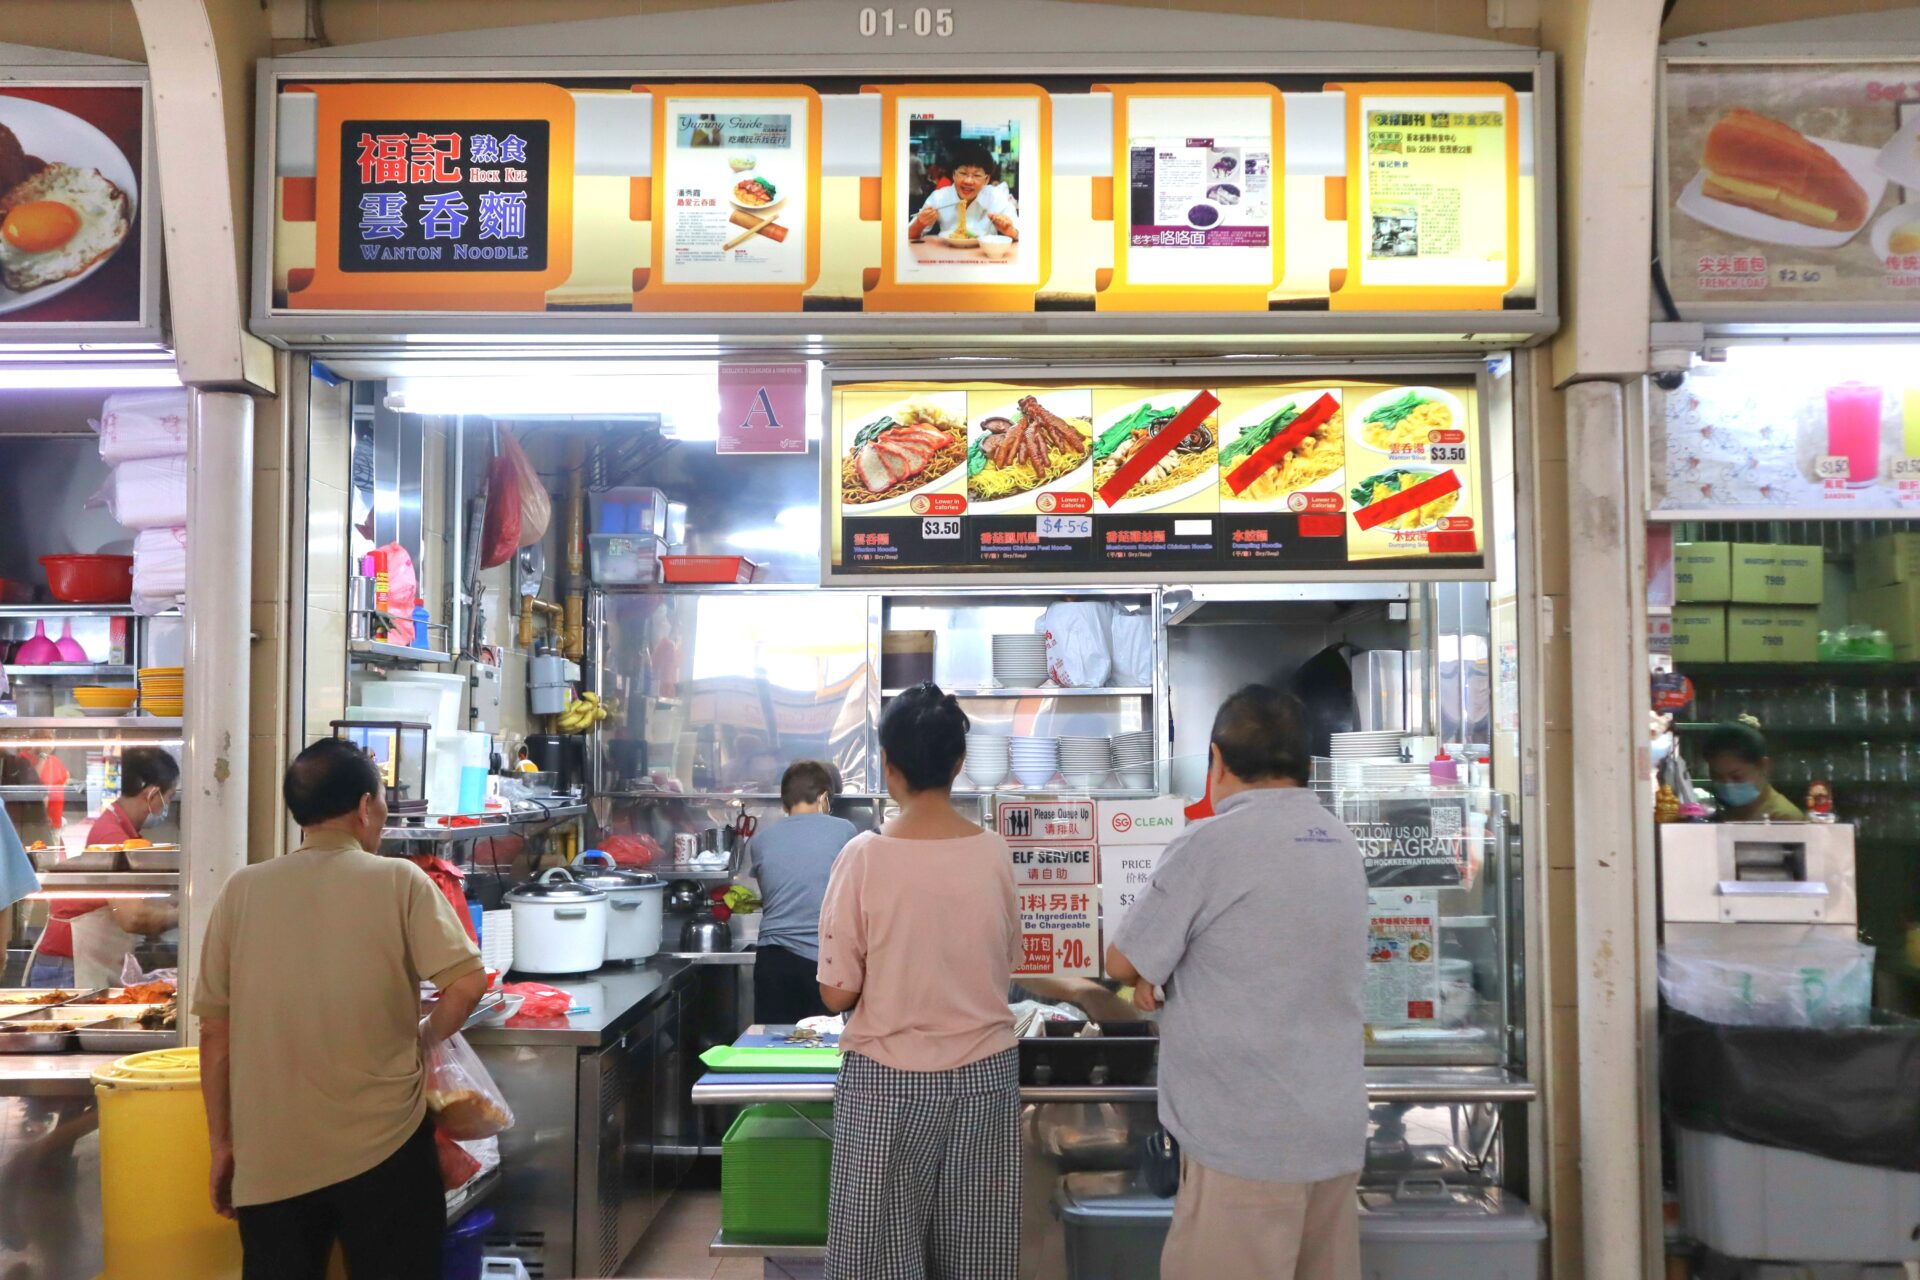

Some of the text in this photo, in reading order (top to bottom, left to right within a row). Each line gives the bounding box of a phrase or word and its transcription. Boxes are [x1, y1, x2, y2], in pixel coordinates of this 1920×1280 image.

[859, 7, 954, 37] 01-05
[679, 116, 726, 132] Yummy
[729, 116, 763, 130] Guide
[470, 134, 528, 163] 熟食
[357, 132, 463, 184] 福記
[1699, 256, 1766, 273] 尖头面包
[739, 386, 784, 428] A
[1431, 447, 1466, 461] $3.50
[924, 521, 959, 535] $3.50
[1034, 808, 1055, 820] Please
[1080, 808, 1089, 821] Up
[1045, 823, 1080, 834] 请排队
[1114, 817, 1174, 827] SG CLEAN
[1396, 826, 1411, 838] US
[1413, 826, 1429, 838] ON
[1359, 838, 1463, 857] NSTAGRAM
[1013, 850, 1090, 864] ELF SERVICE
[1121, 860, 1152, 869] PRICE
[1028, 868, 1068, 880] 请自助
[1036, 912, 1087, 921] Ingredients
[1039, 921, 1091, 930] Chargeable
